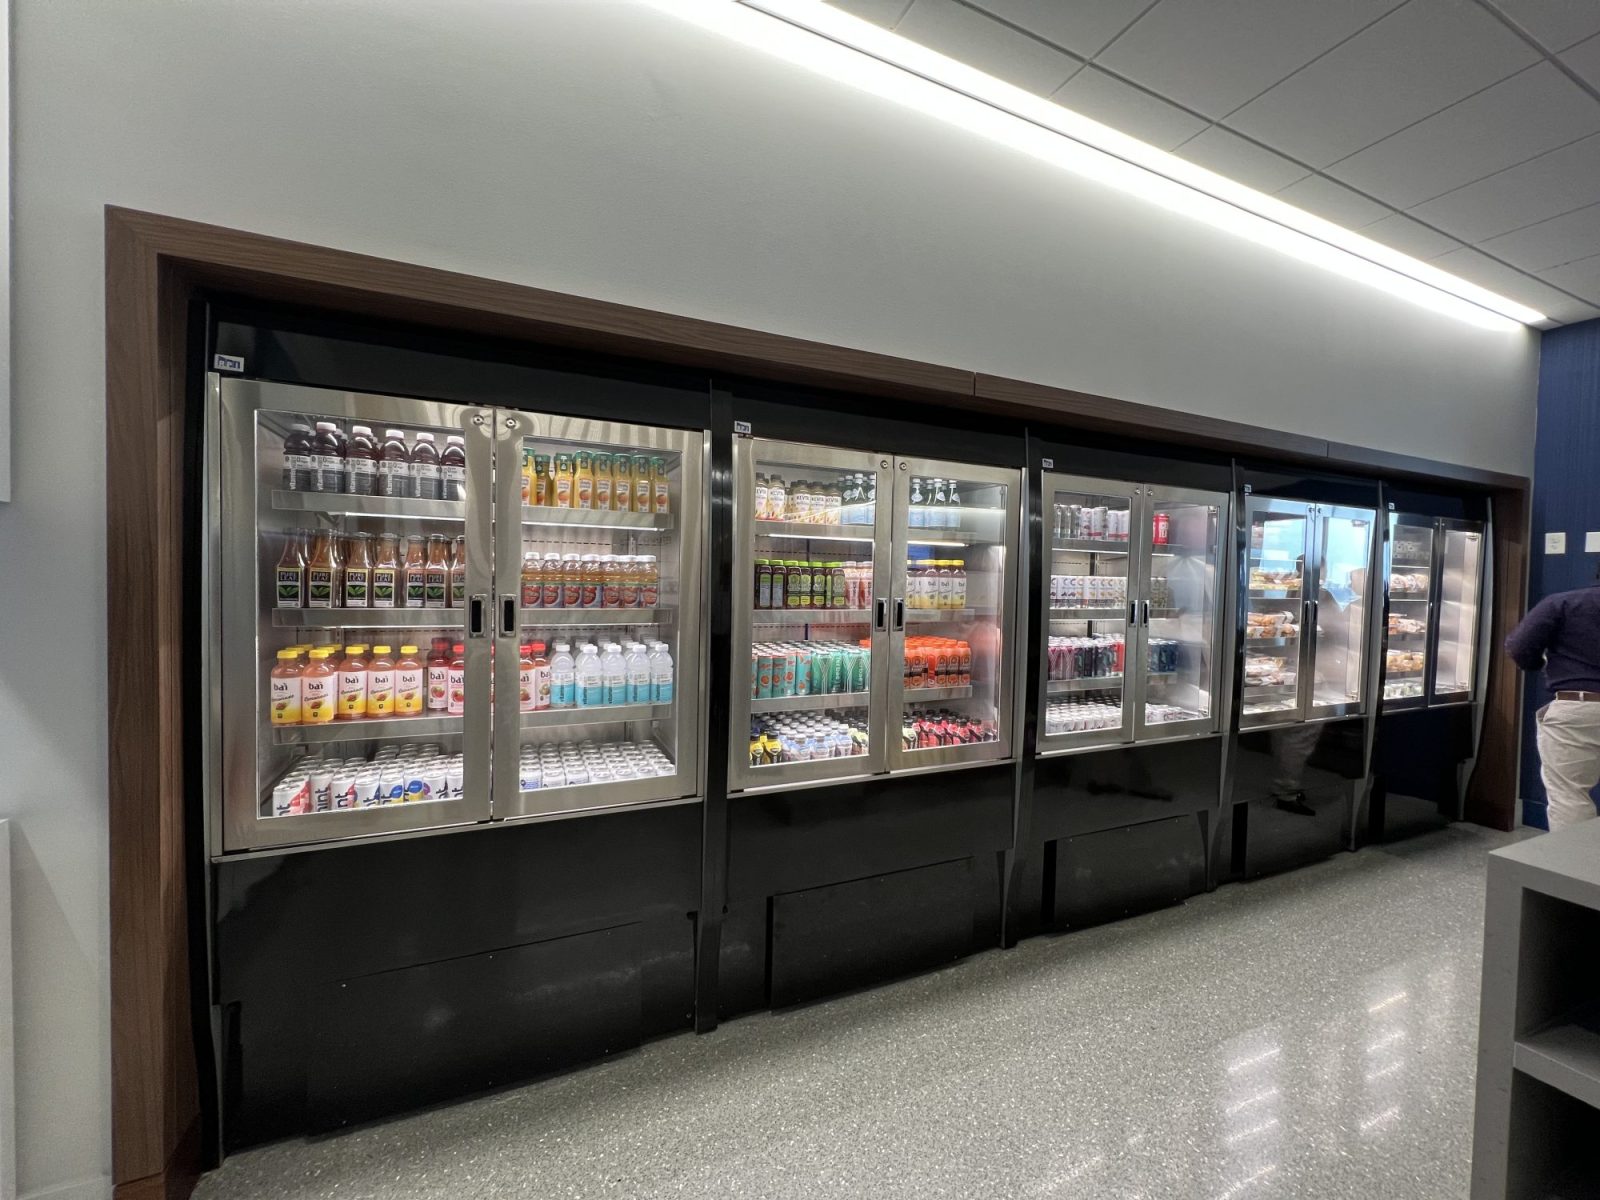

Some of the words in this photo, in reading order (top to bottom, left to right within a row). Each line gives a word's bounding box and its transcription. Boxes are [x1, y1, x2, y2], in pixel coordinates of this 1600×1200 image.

[375, 675, 388, 684] bai
[402, 674, 415, 682] bai
[430, 670, 444, 680] bai
[345, 676, 359, 684] bai
[273, 682, 288, 691] bai
[308, 681, 323, 690] bai
